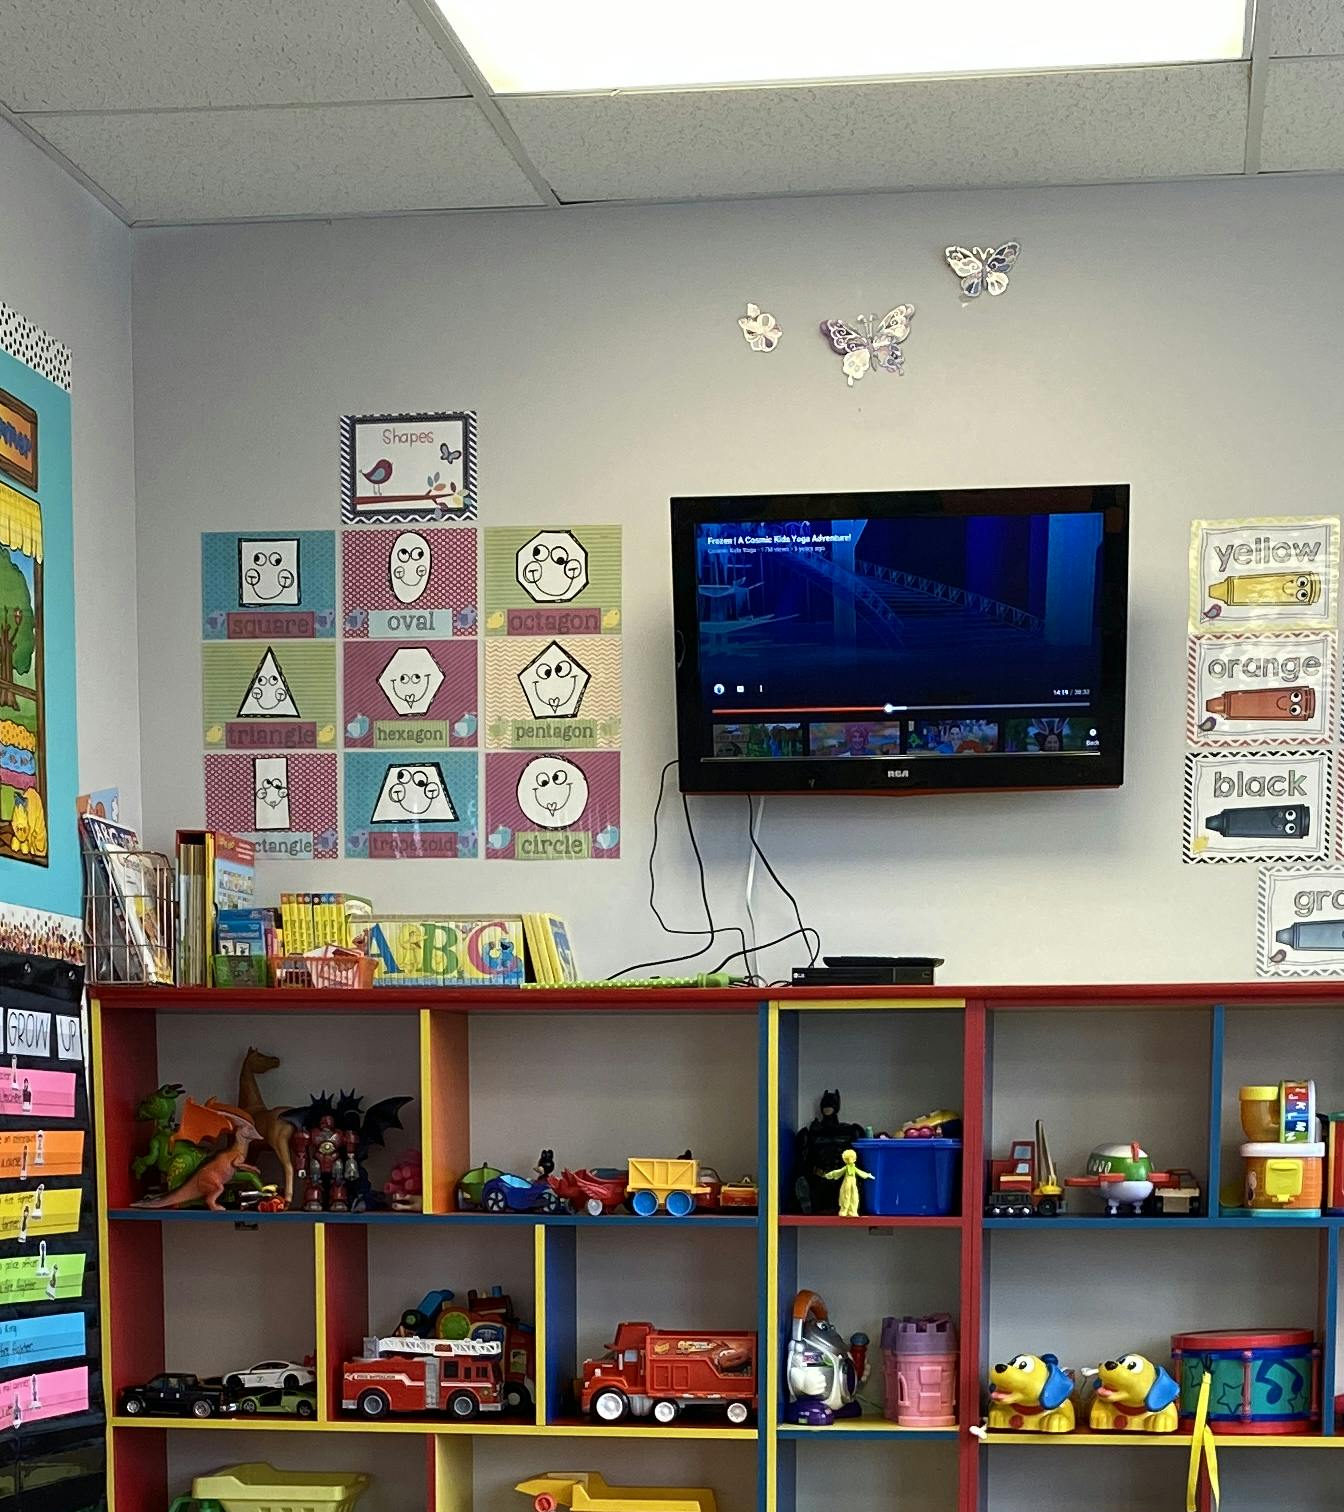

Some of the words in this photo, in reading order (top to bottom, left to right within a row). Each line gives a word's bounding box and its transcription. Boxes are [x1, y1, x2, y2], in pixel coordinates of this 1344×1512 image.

[382, 428, 434, 447] Shapes
[747, 536, 772, 544] Cosmic
[791, 535, 810, 543] Yoga
[1213, 536, 1321, 572] yellow
[233, 615, 309, 638] square
[387, 611, 436, 631] oval
[511, 612, 599, 635] octagon
[1208, 650, 1321, 681] orange
[228, 724, 315, 745] triangle
[377, 726, 443, 744] hexagon
[516, 723, 594, 741] pentagon
[1213, 770, 1307, 798] black
[253, 836, 313, 856] ctangle
[372, 835, 453, 856] trapezoid
[521, 834, 583, 855] circle
[8, 1012, 49, 1050] GROW
[60, 1018, 76, 1052] UP
